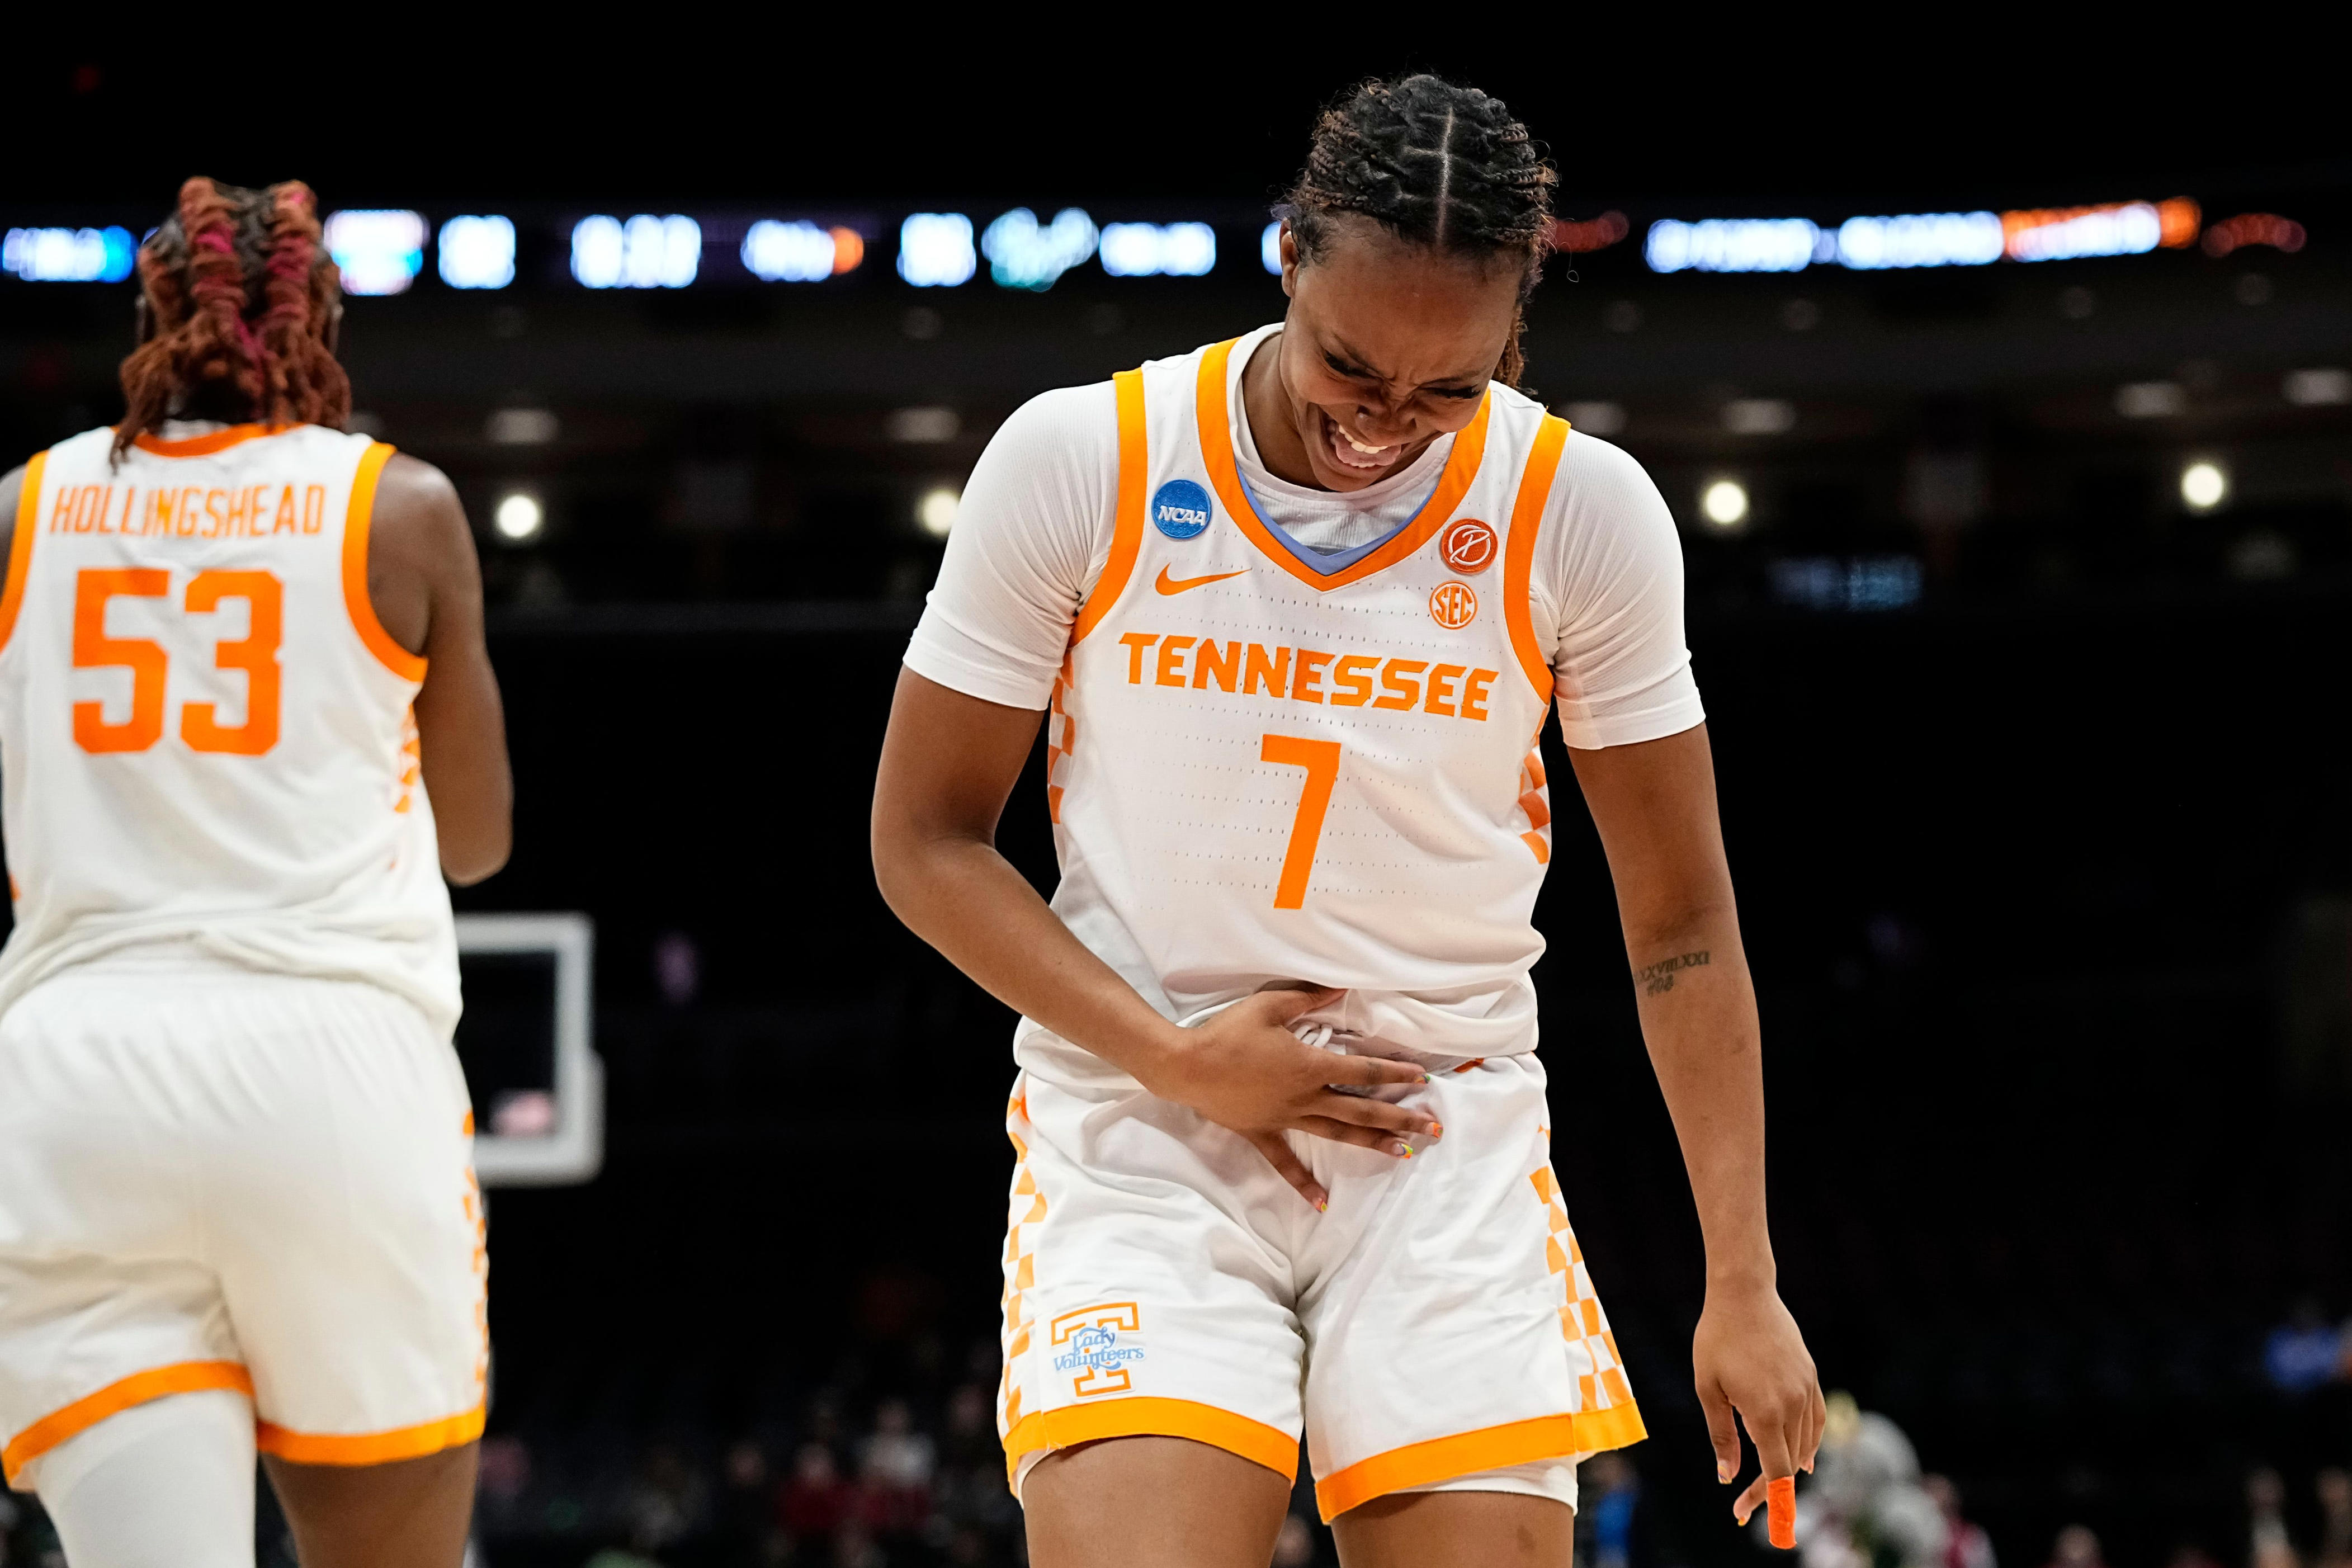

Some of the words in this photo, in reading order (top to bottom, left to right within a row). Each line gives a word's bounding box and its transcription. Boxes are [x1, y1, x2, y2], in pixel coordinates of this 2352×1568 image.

[50, 483, 326, 537] HOLLINGSHEAD
[1158, 505, 1207, 526] NCAA
[1435, 585, 1473, 625] SEC
[72, 568, 283, 757] 53
[1118, 632, 1499, 721] TENNESSEE
[1260, 734, 1342, 910] 7
[1054, 1348, 1145, 1371] Volunteers
[1073, 1326, 1116, 1350] Lady
